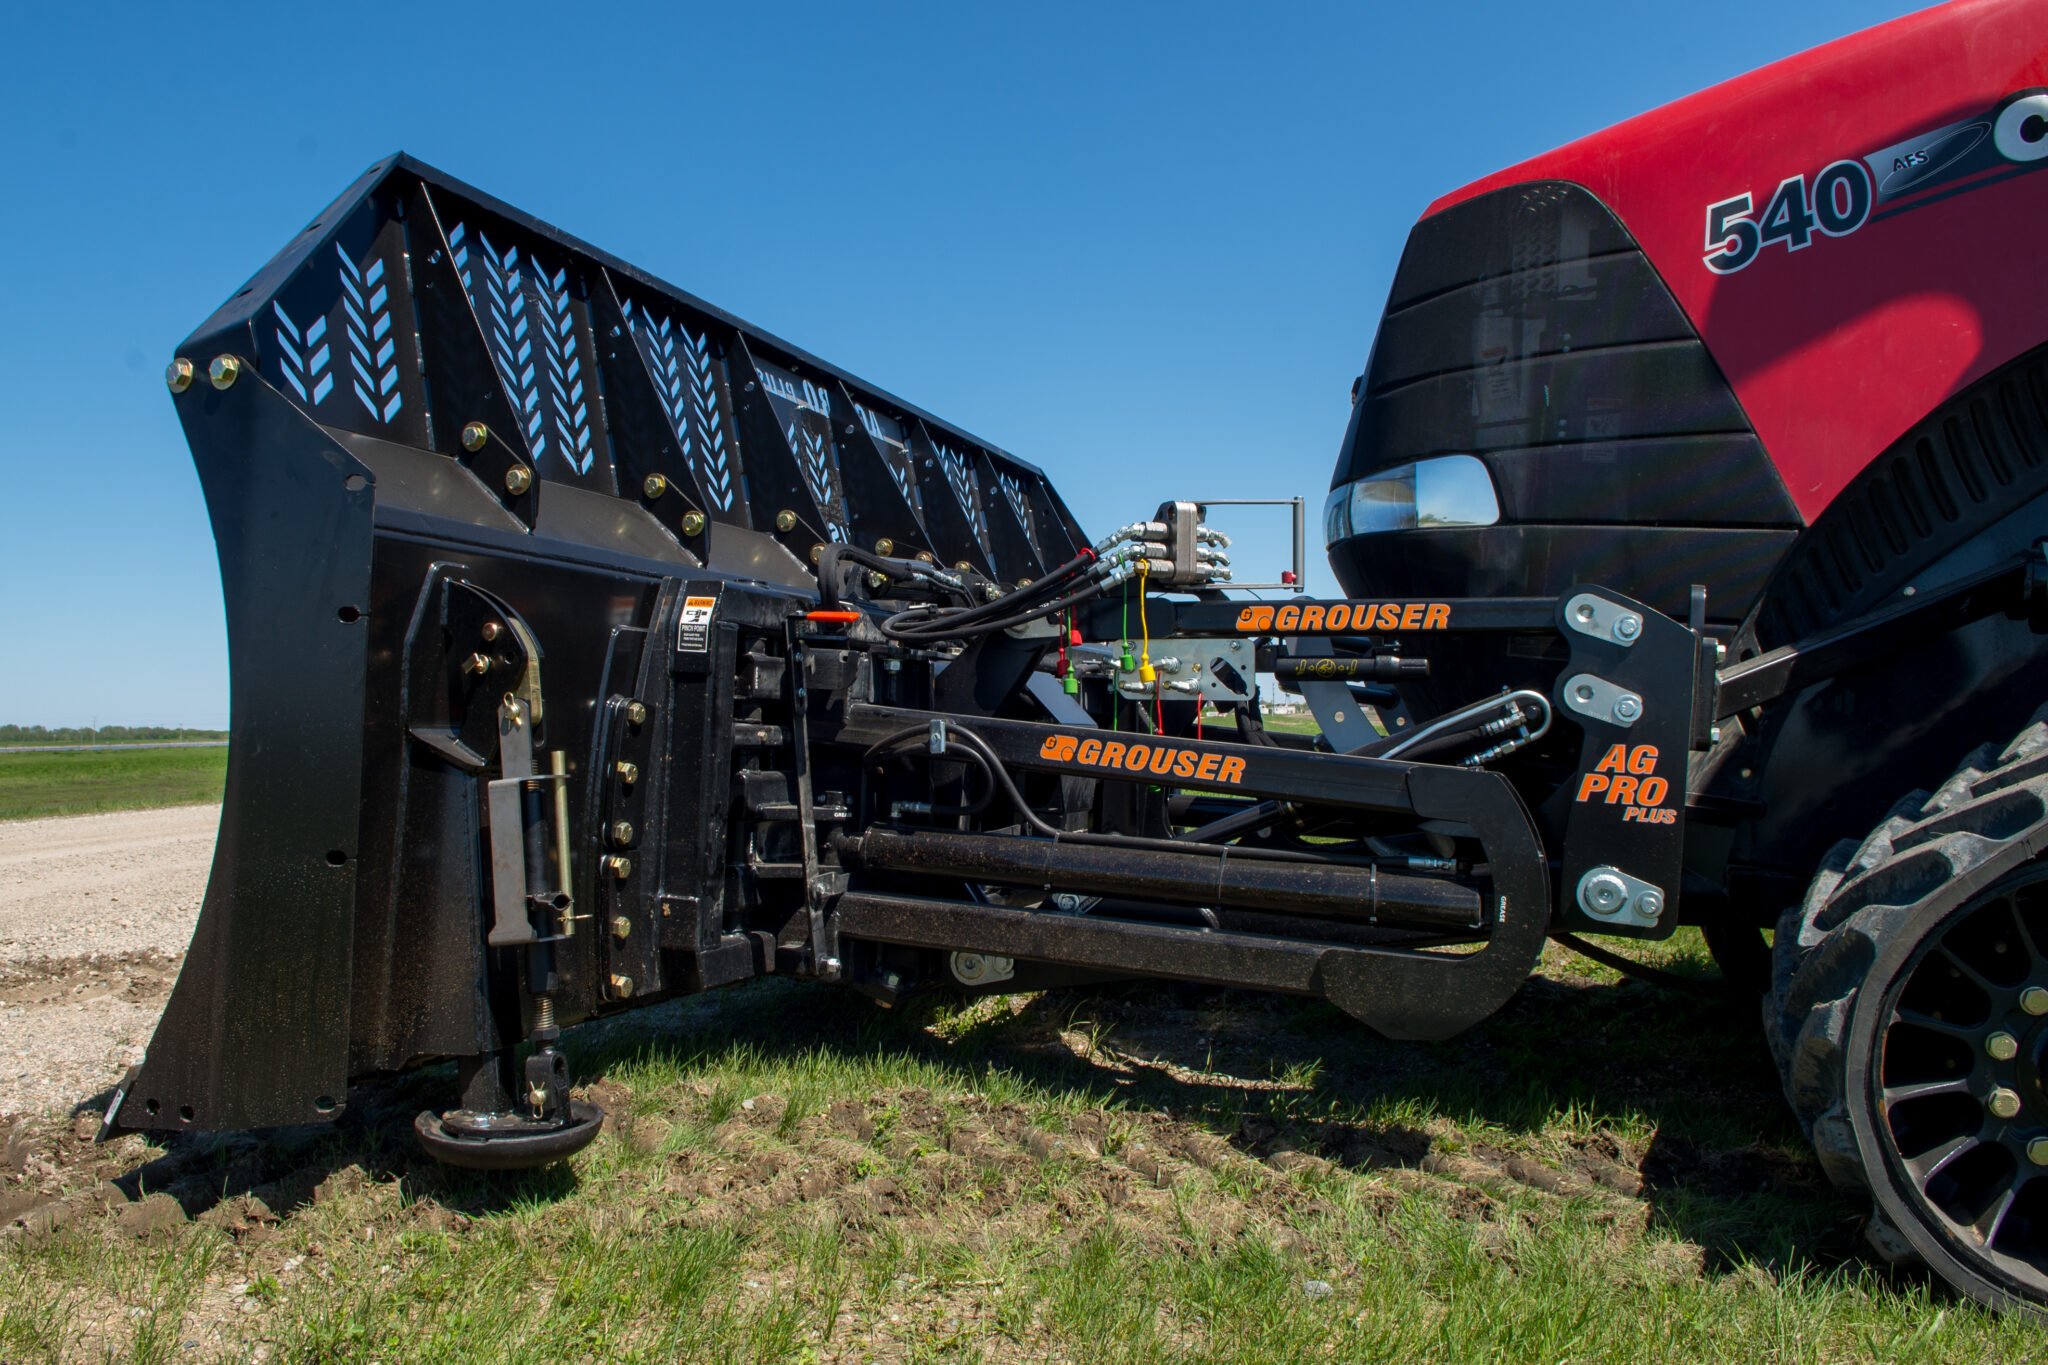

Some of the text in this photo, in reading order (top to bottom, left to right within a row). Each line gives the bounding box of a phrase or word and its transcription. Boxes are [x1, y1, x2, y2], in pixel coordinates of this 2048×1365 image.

[1893, 150, 1929, 172] AFS
[1702, 159, 1872, 275] 540
[1275, 603, 1451, 632] GROUSER
[1077, 738, 1247, 784] GROUSER
[1594, 744, 1659, 775] AG
[1575, 773, 1669, 807] PRO
[1622, 806, 1678, 825] PLUS
